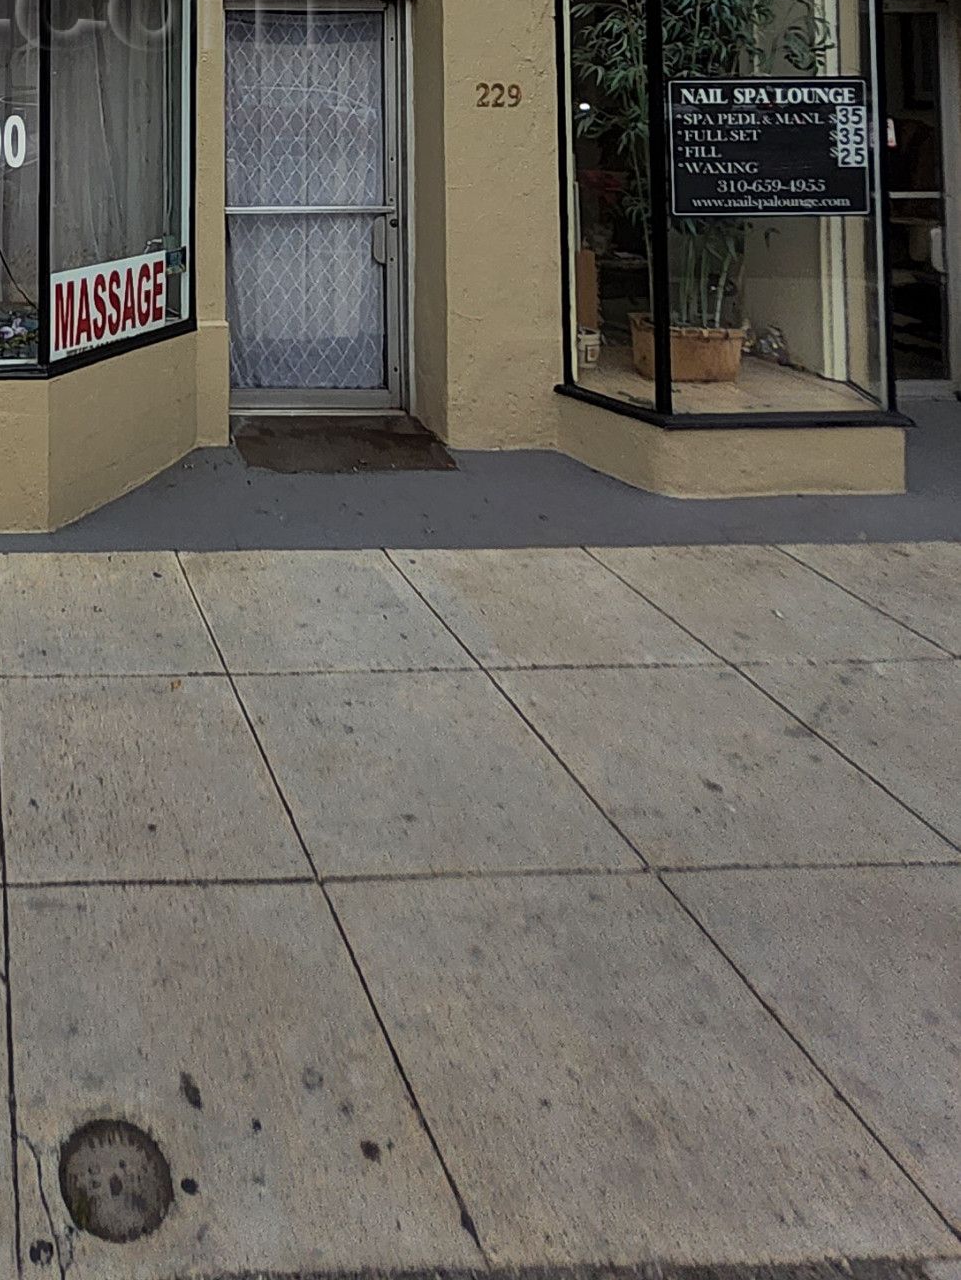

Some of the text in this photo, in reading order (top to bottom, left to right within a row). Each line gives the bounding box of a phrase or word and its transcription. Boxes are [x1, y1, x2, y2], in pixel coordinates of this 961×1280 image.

[476, 82, 523, 108] 229
[680, 87, 856, 104] NAIL SPA LOUNGE
[682, 113, 714, 125] SPA
[761, 115, 772, 125] &
[684, 130, 728, 142] FULL
[729, 130, 762, 142] SET
[685, 146, 722, 158] FILL
[686, 162, 759, 174] WAXING
[716, 179, 827, 193] 310-659-4955
[691, 195, 851, 210] www.nailspalounge.com
[54, 260, 164, 351] MASSAGE
